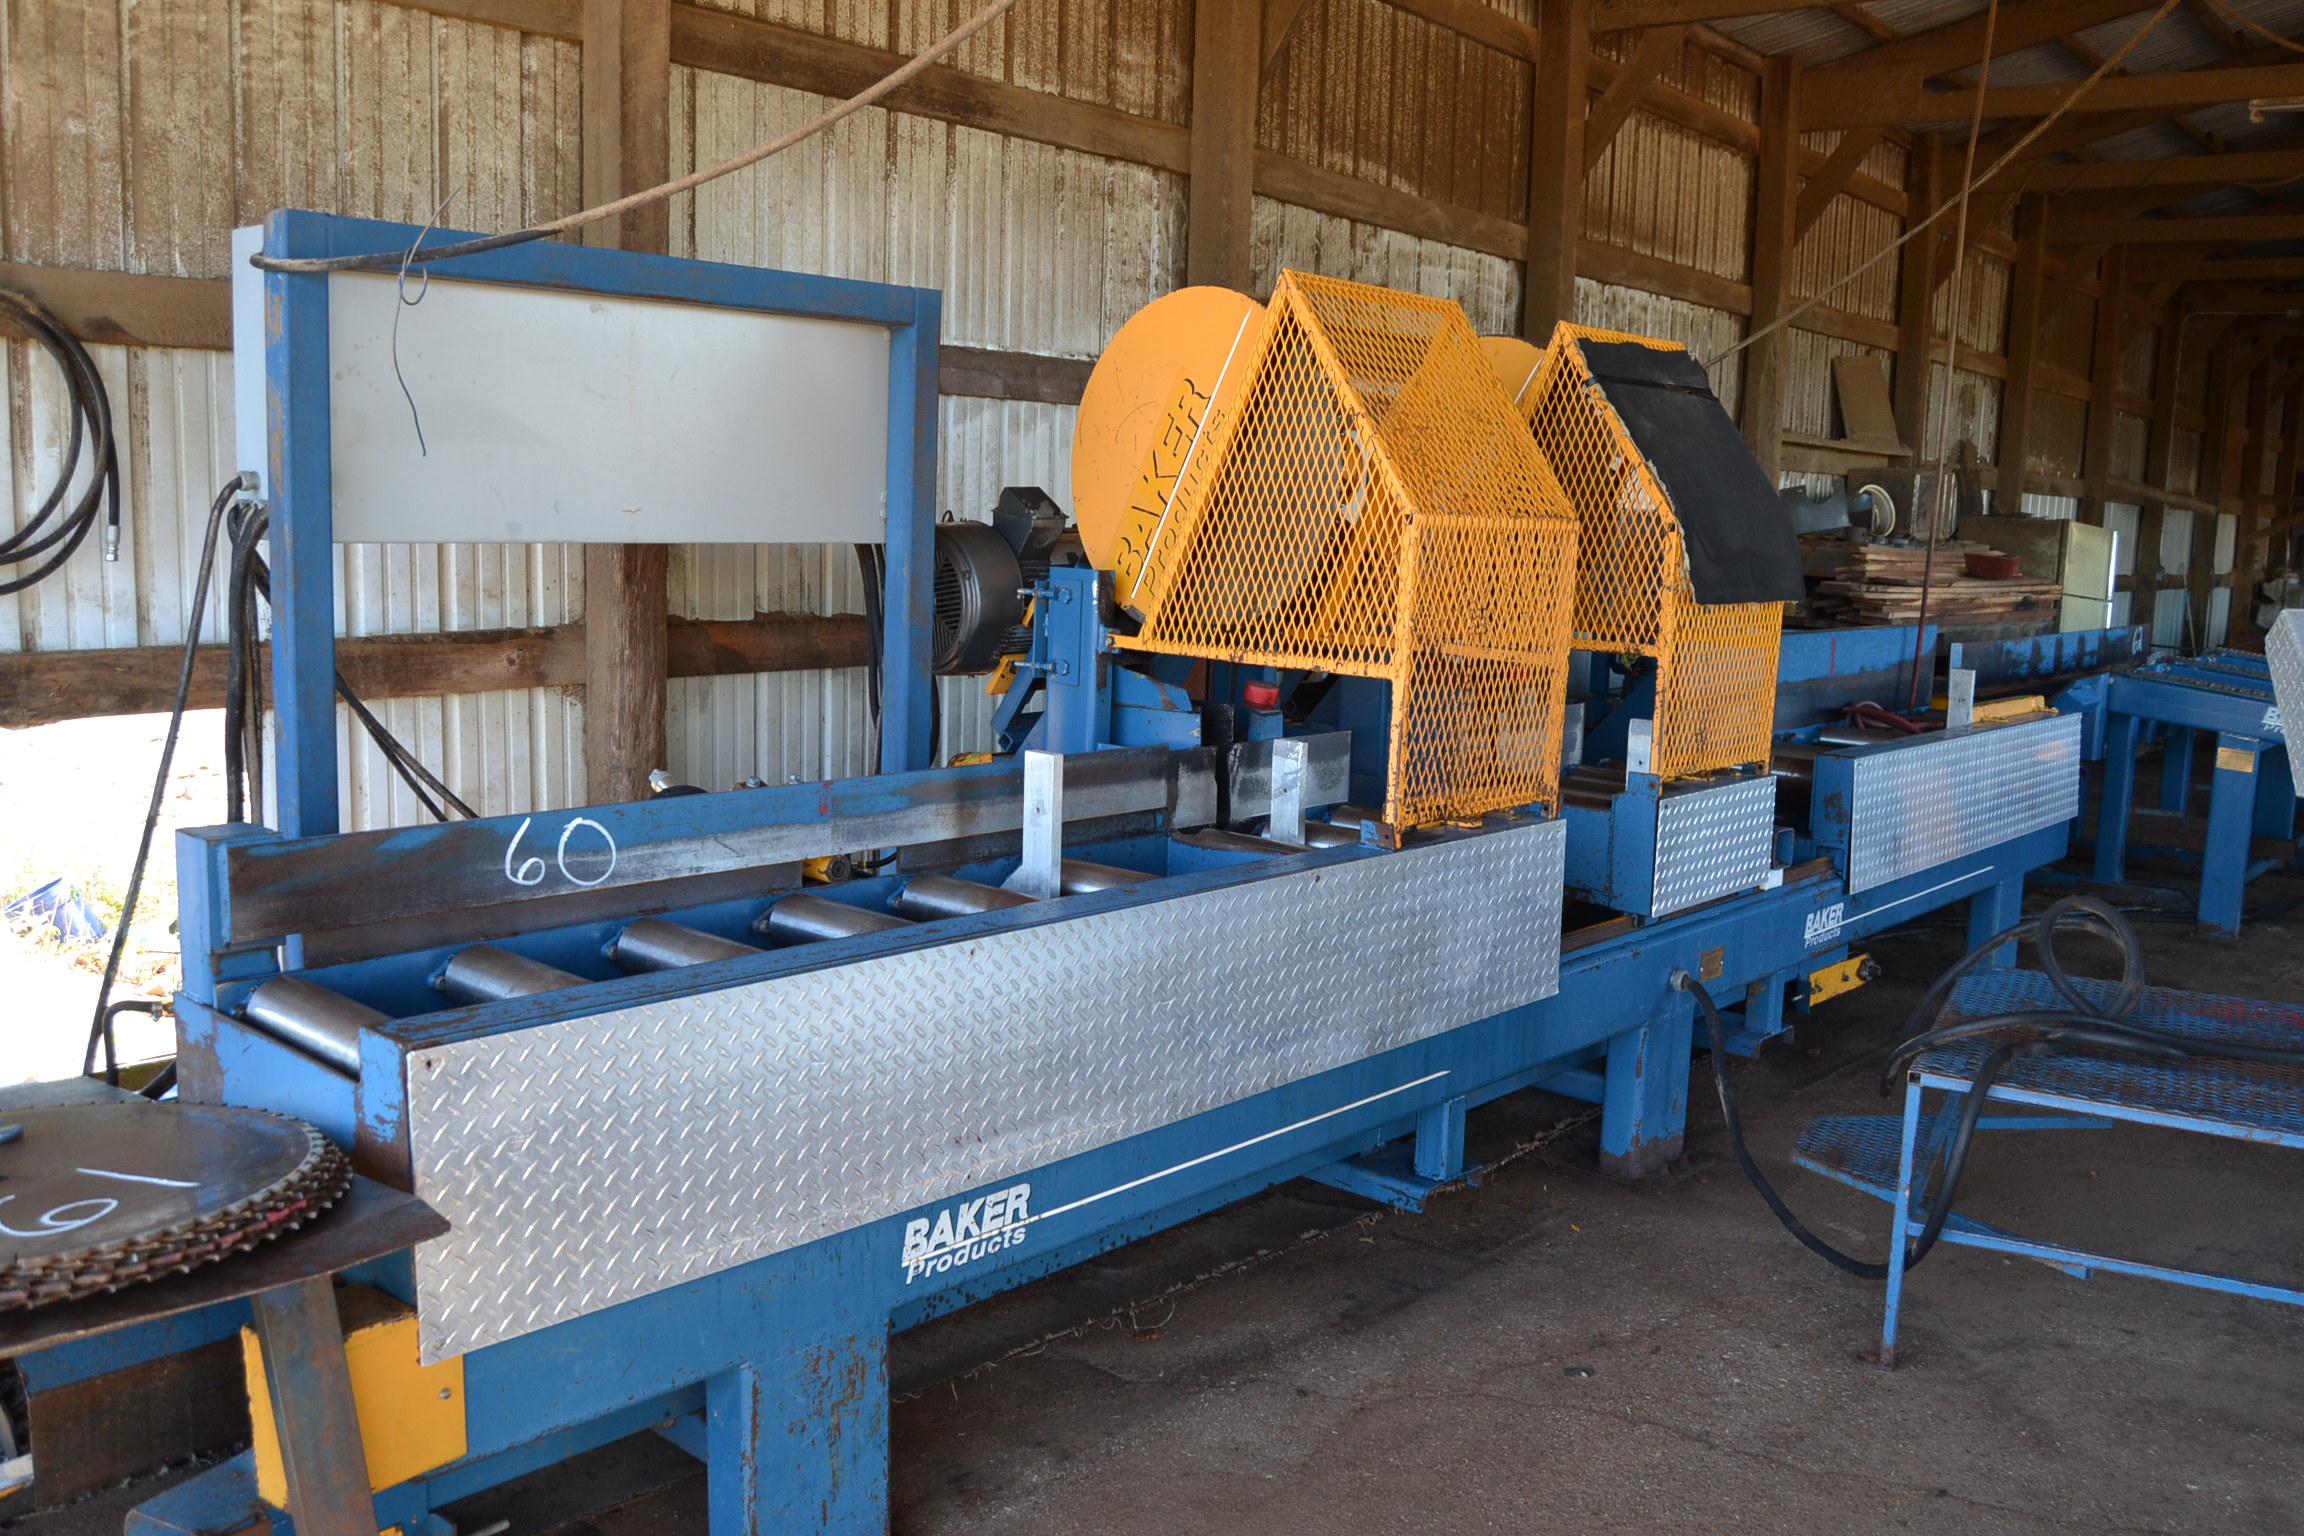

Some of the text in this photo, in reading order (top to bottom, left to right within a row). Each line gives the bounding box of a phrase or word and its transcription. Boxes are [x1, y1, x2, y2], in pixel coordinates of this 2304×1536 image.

[1115, 377, 1213, 583] BAKER
[504, 816, 617, 886] 60
[1804, 902, 1845, 938] BAKER
[1804, 927, 1842, 949] Products
[901, 1182, 1032, 1264] BAKER
[905, 1226, 1027, 1285] Products
